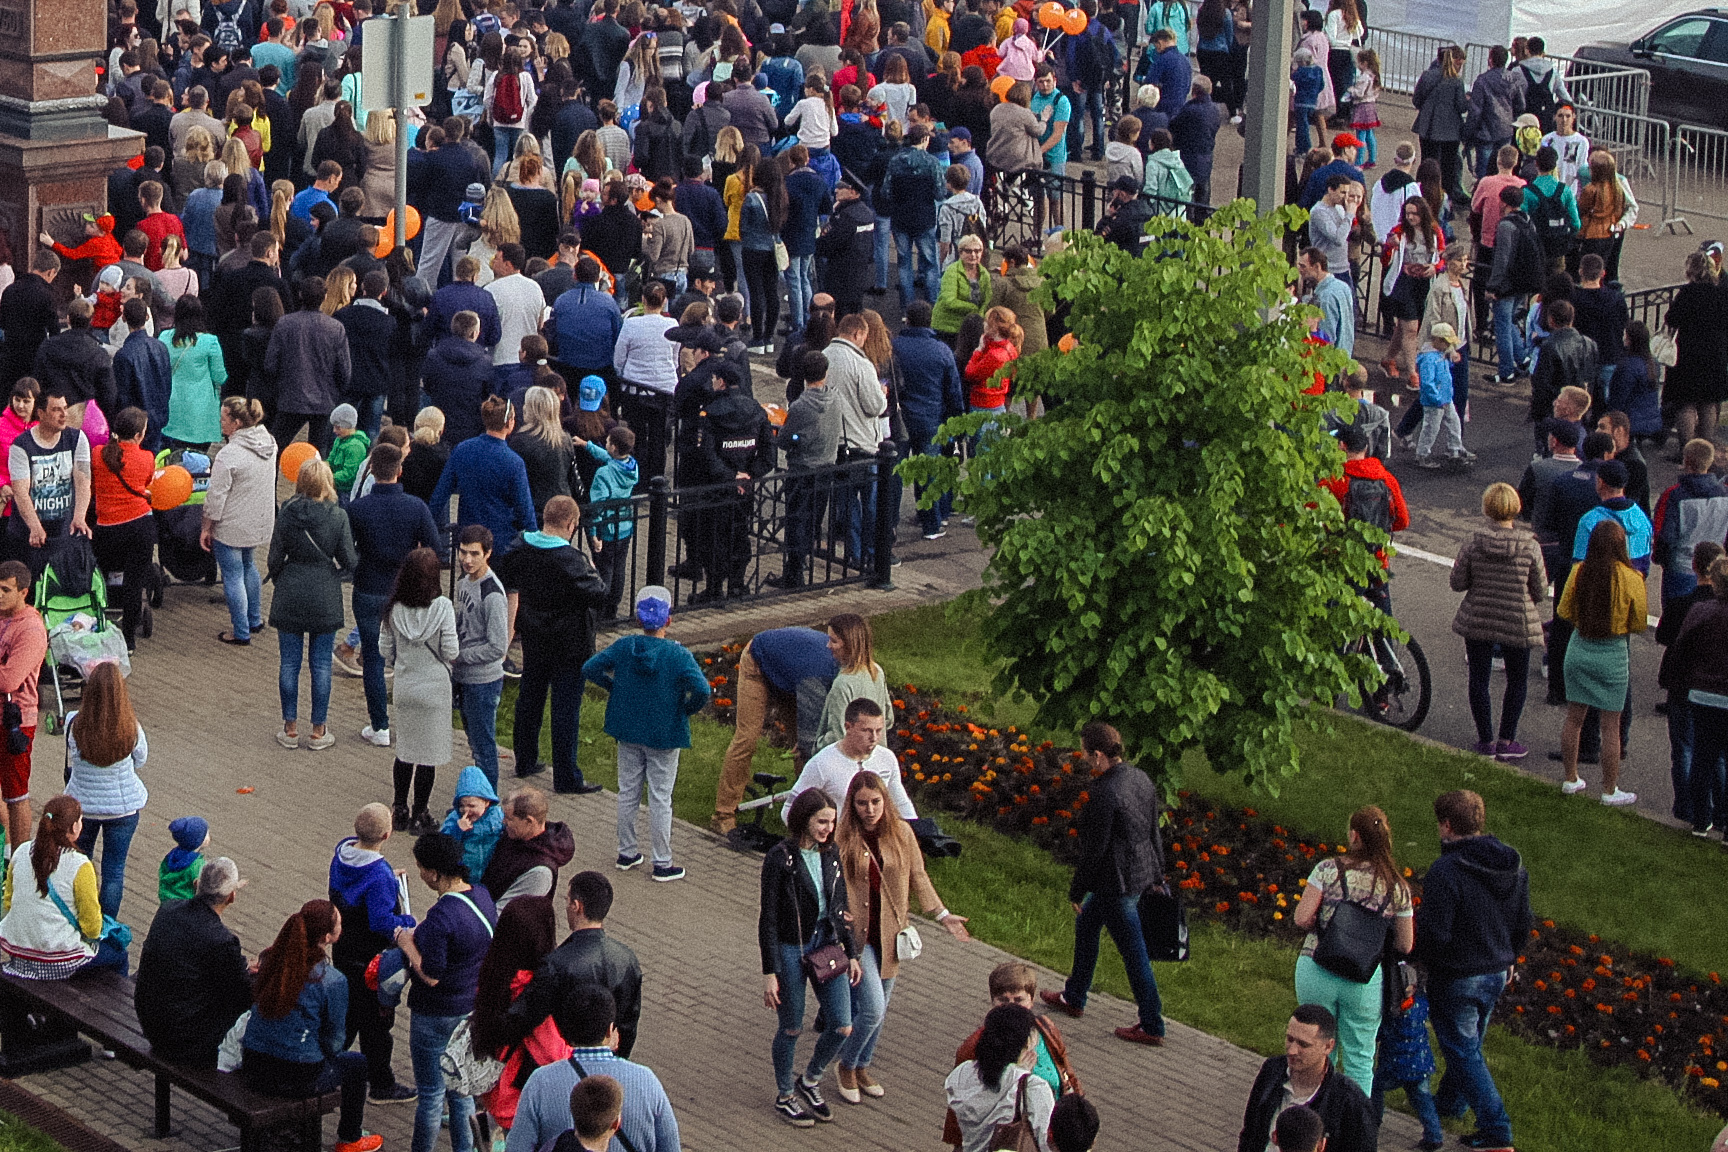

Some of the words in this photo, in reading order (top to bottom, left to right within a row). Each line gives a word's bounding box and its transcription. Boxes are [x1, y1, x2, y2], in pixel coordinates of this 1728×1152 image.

[722, 439, 756, 449] ПОЛИЦИЯ
[42, 464, 61, 480] DAY
[34, 495, 71, 511] NIGHT
